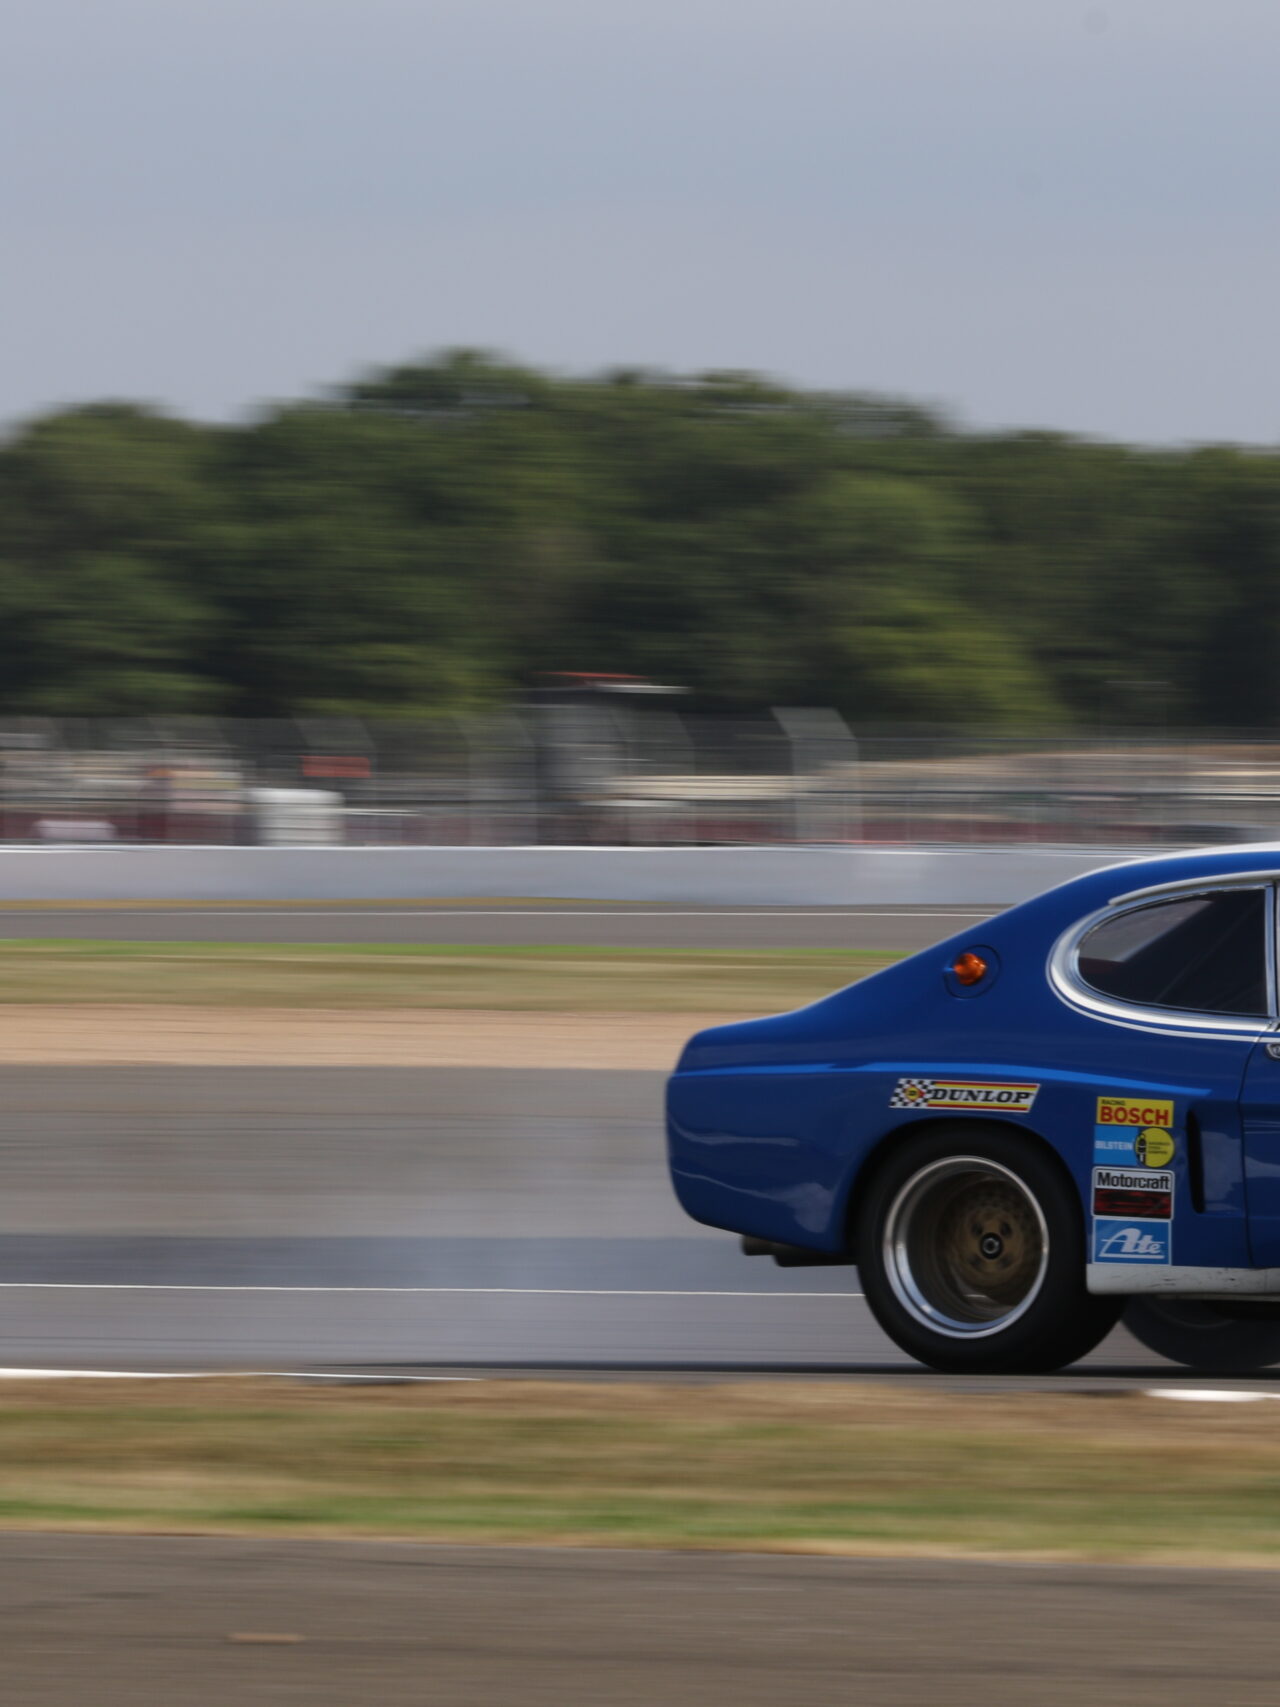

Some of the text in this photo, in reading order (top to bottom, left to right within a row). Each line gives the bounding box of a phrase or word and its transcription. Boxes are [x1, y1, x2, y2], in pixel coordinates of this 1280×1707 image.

[929, 1088, 1033, 1104] DUNLOP
[1099, 1106, 1170, 1126] BOSCH
[1095, 1140, 1134, 1151] BILSTEIN
[1097, 1171, 1170, 1190] Motorcraft
